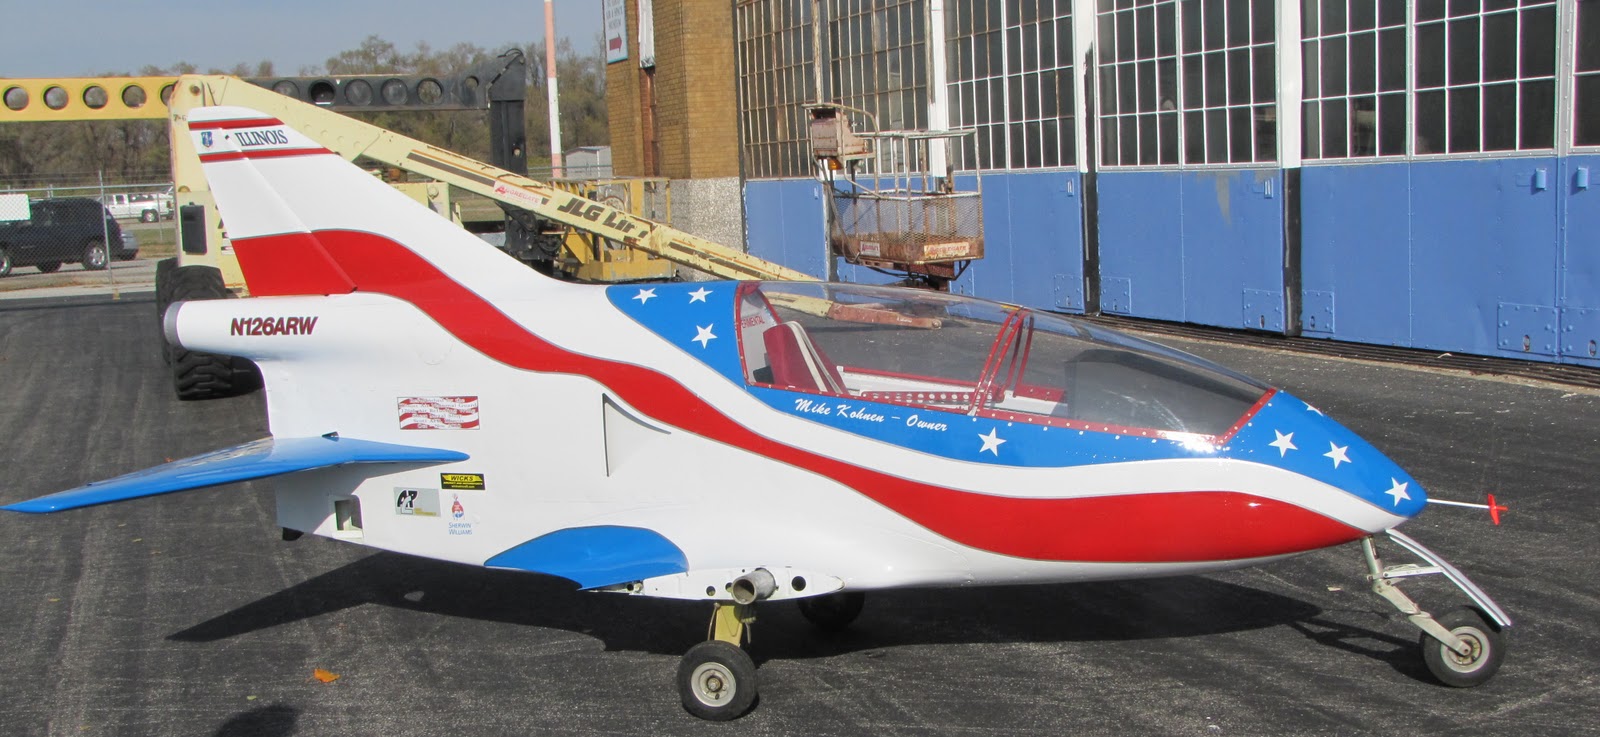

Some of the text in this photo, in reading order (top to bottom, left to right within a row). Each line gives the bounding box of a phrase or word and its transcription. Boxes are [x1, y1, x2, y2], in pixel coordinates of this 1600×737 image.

[234, 129, 288, 147] ILLINOIS
[557, 197, 605, 222] JLG
[230, 316, 319, 336] N126ARW
[794, 398, 831, 415] Mike
[836, 404, 885, 423] Kohnen
[906, 414, 948, 432] Owner
